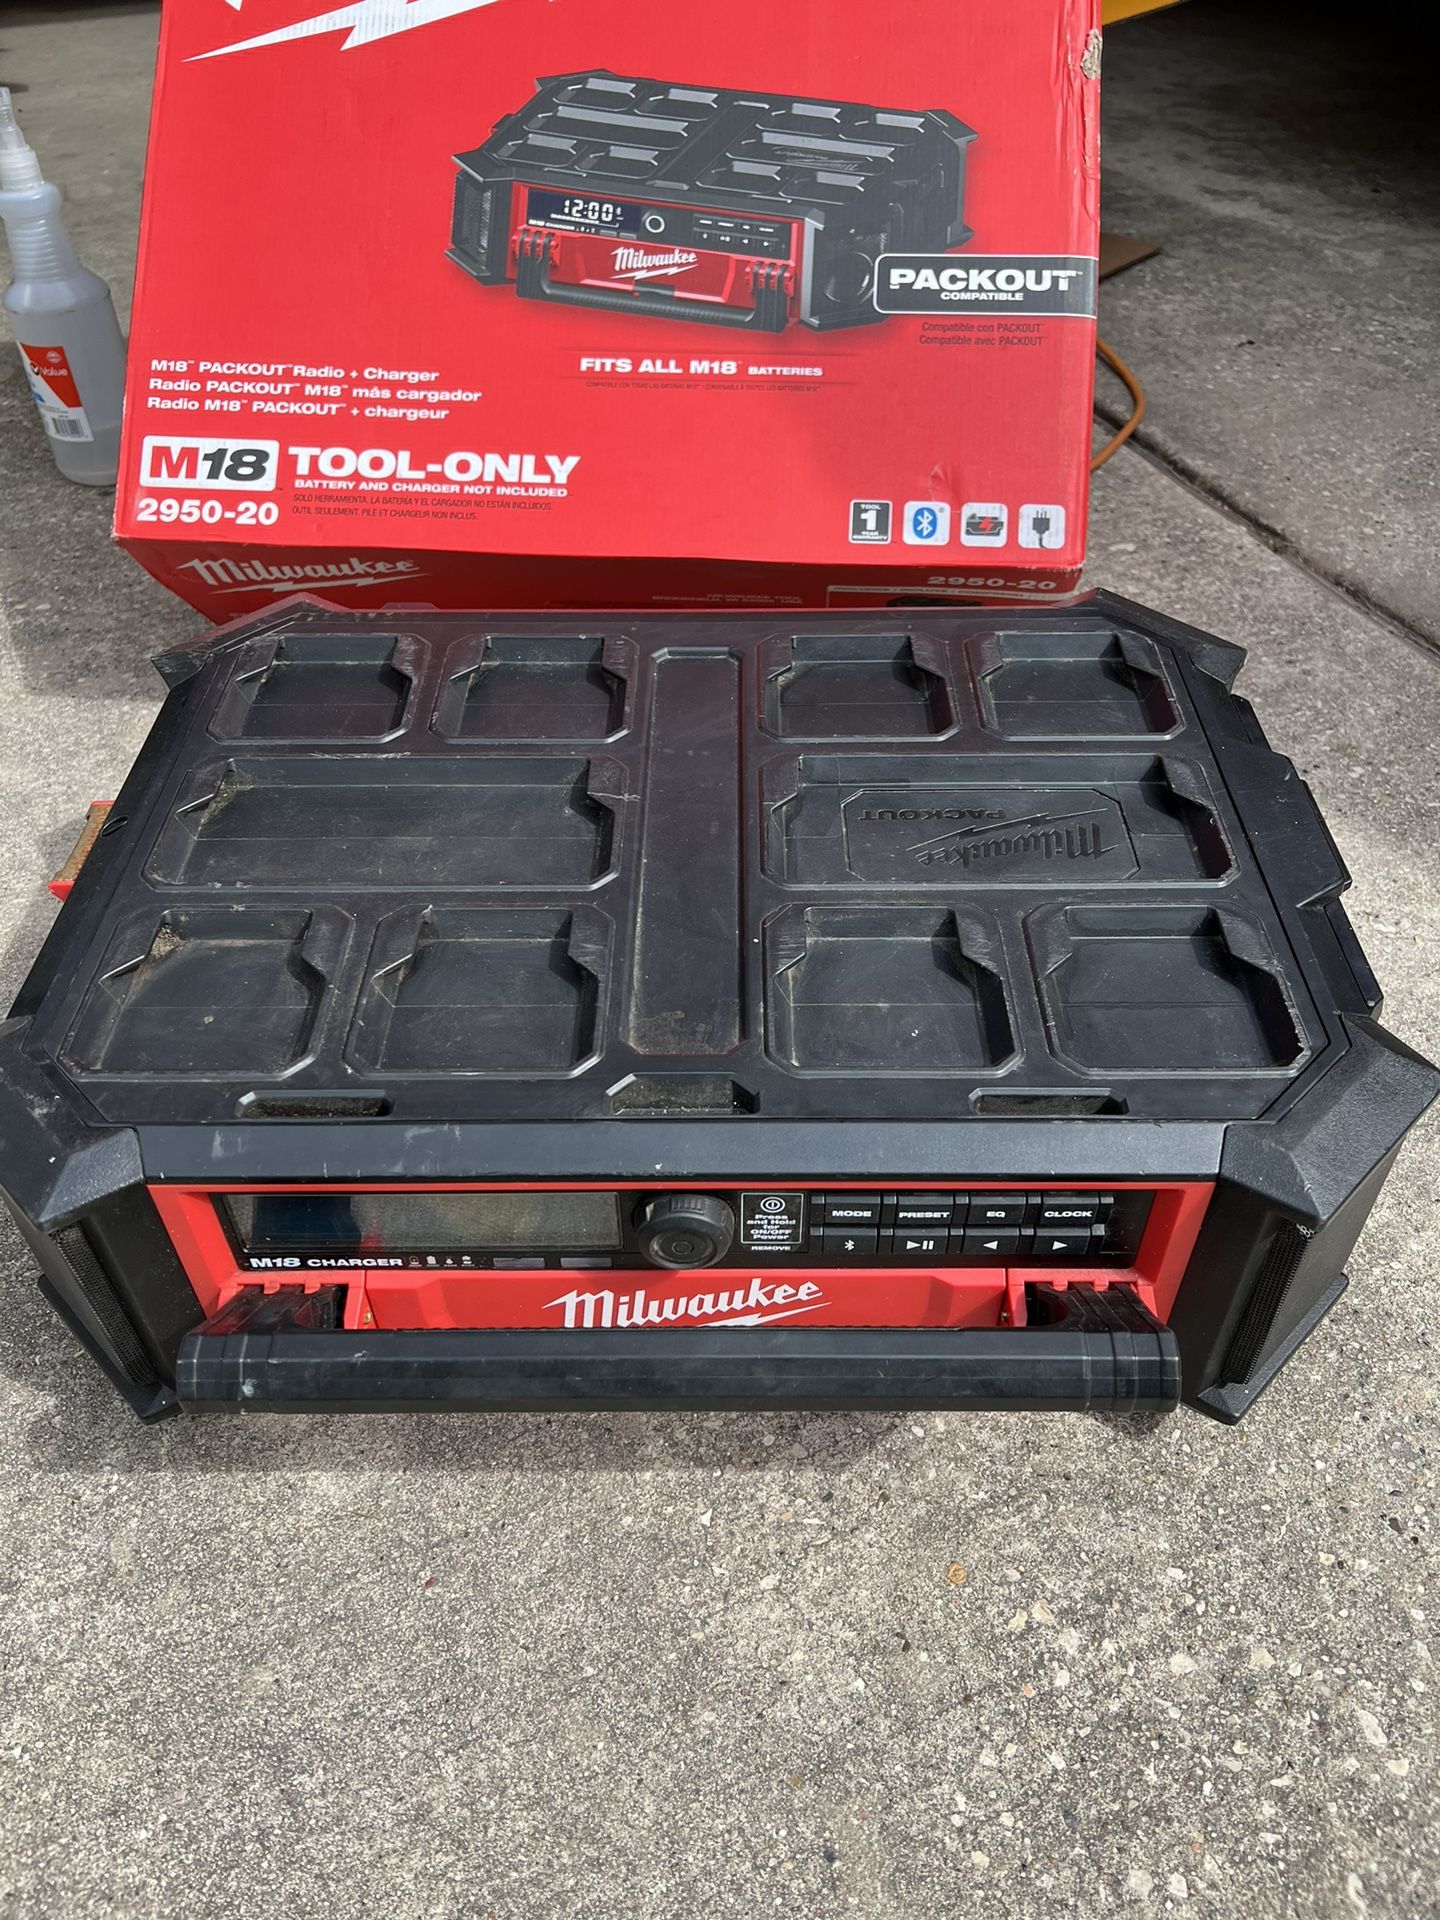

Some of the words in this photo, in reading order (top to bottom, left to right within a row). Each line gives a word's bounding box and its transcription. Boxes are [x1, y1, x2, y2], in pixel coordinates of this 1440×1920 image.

[564, 199, 614, 222] 12:00
[610, 246, 698, 271] Milwaukee
[940, 291, 1024, 301] COMPATIBLE
[922, 322, 975, 334] Compatible
[977, 324, 994, 333] con
[919, 335, 973, 346] Compatible
[974, 337, 995, 346] avec
[293, 364, 345, 378] Radio
[363, 367, 440, 384] Charger
[580, 357, 633, 373] FITS
[637, 358, 684, 374] ALL
[747, 365, 824, 377] BATTERIES
[149, 378, 201, 392] Radio
[352, 386, 391, 399] más
[396, 388, 482, 403] cargador
[148, 397, 199, 410] Radio
[364, 404, 450, 421] chargeur
[148, 445, 270, 481] M18
[288, 446, 581, 485] TOOL-ONLY
[294, 479, 356, 490] BATTERY
[358, 481, 389, 491] AND
[391, 482, 461, 494] CHARGER
[463, 485, 493, 495] NOT
[496, 485, 568, 497] INCLUDED
[135, 497, 280, 526] 2950-20
[860, 509, 877, 531] 1
[176, 557, 425, 588] Milwaukee
[927, 576, 1057, 590] 2950-20
[831, 1210, 872, 1218] MODE
[898, 1211, 951, 1219] PRESET
[985, 1210, 1006, 1218] EQ
[1043, 1210, 1093, 1218] CLOCK
[249, 1257, 302, 1268] M18
[306, 1258, 403, 1268] CHARGER
[541, 1277, 823, 1328] Milwaukee
